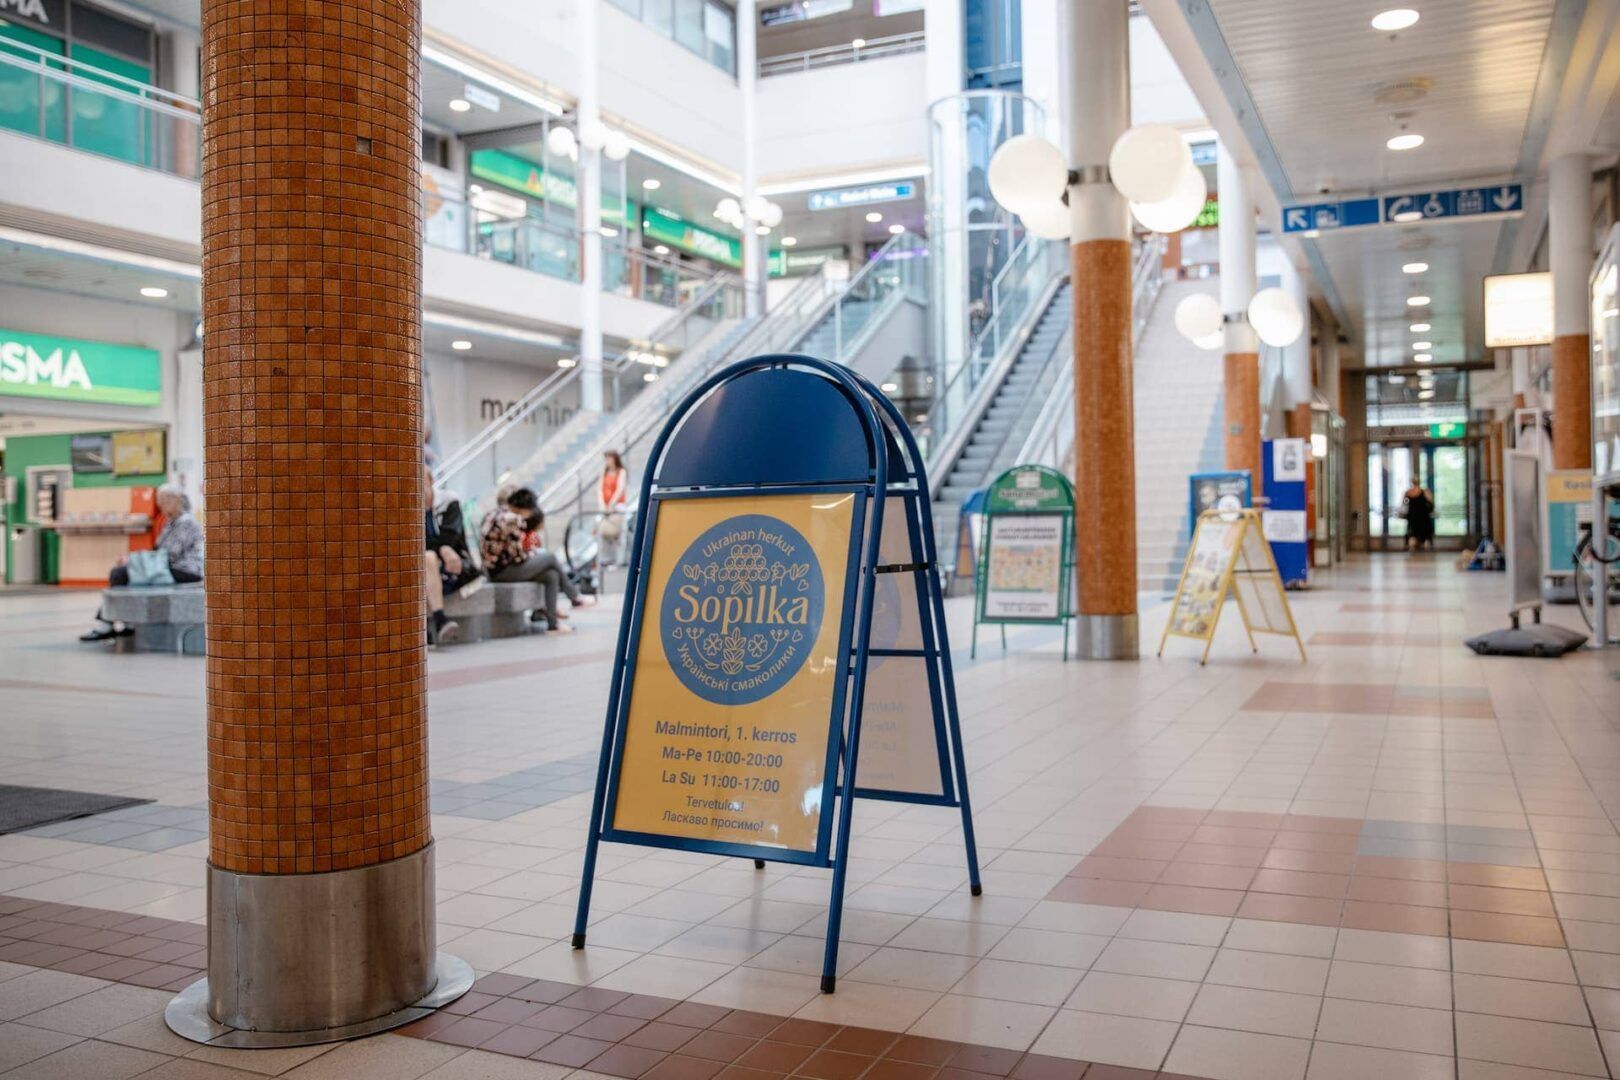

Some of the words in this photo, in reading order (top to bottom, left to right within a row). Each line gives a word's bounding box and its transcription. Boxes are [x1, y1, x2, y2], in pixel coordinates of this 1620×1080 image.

[0, 341, 93, 390] SMA
[703, 530, 755, 558] Ukrainan
[758, 528, 796, 557] herkut
[674, 585, 809, 635] Sopilka
[677, 642, 729, 691] Українські
[731, 645, 796, 692] смаколики
[655, 720, 731, 742] Malmintori,
[736, 726, 748, 741] 1.
[752, 726, 797, 744] kerros
[662, 746, 702, 761] Ma-Pe
[706, 750, 783, 768] 10:00-20:00
[662, 770, 676, 784] La
[679, 771, 695, 785] Su
[703, 774, 780, 793] 11:00-17:00
[662, 810, 708, 826] Ласкаво
[711, 817, 764, 832] просимо!
